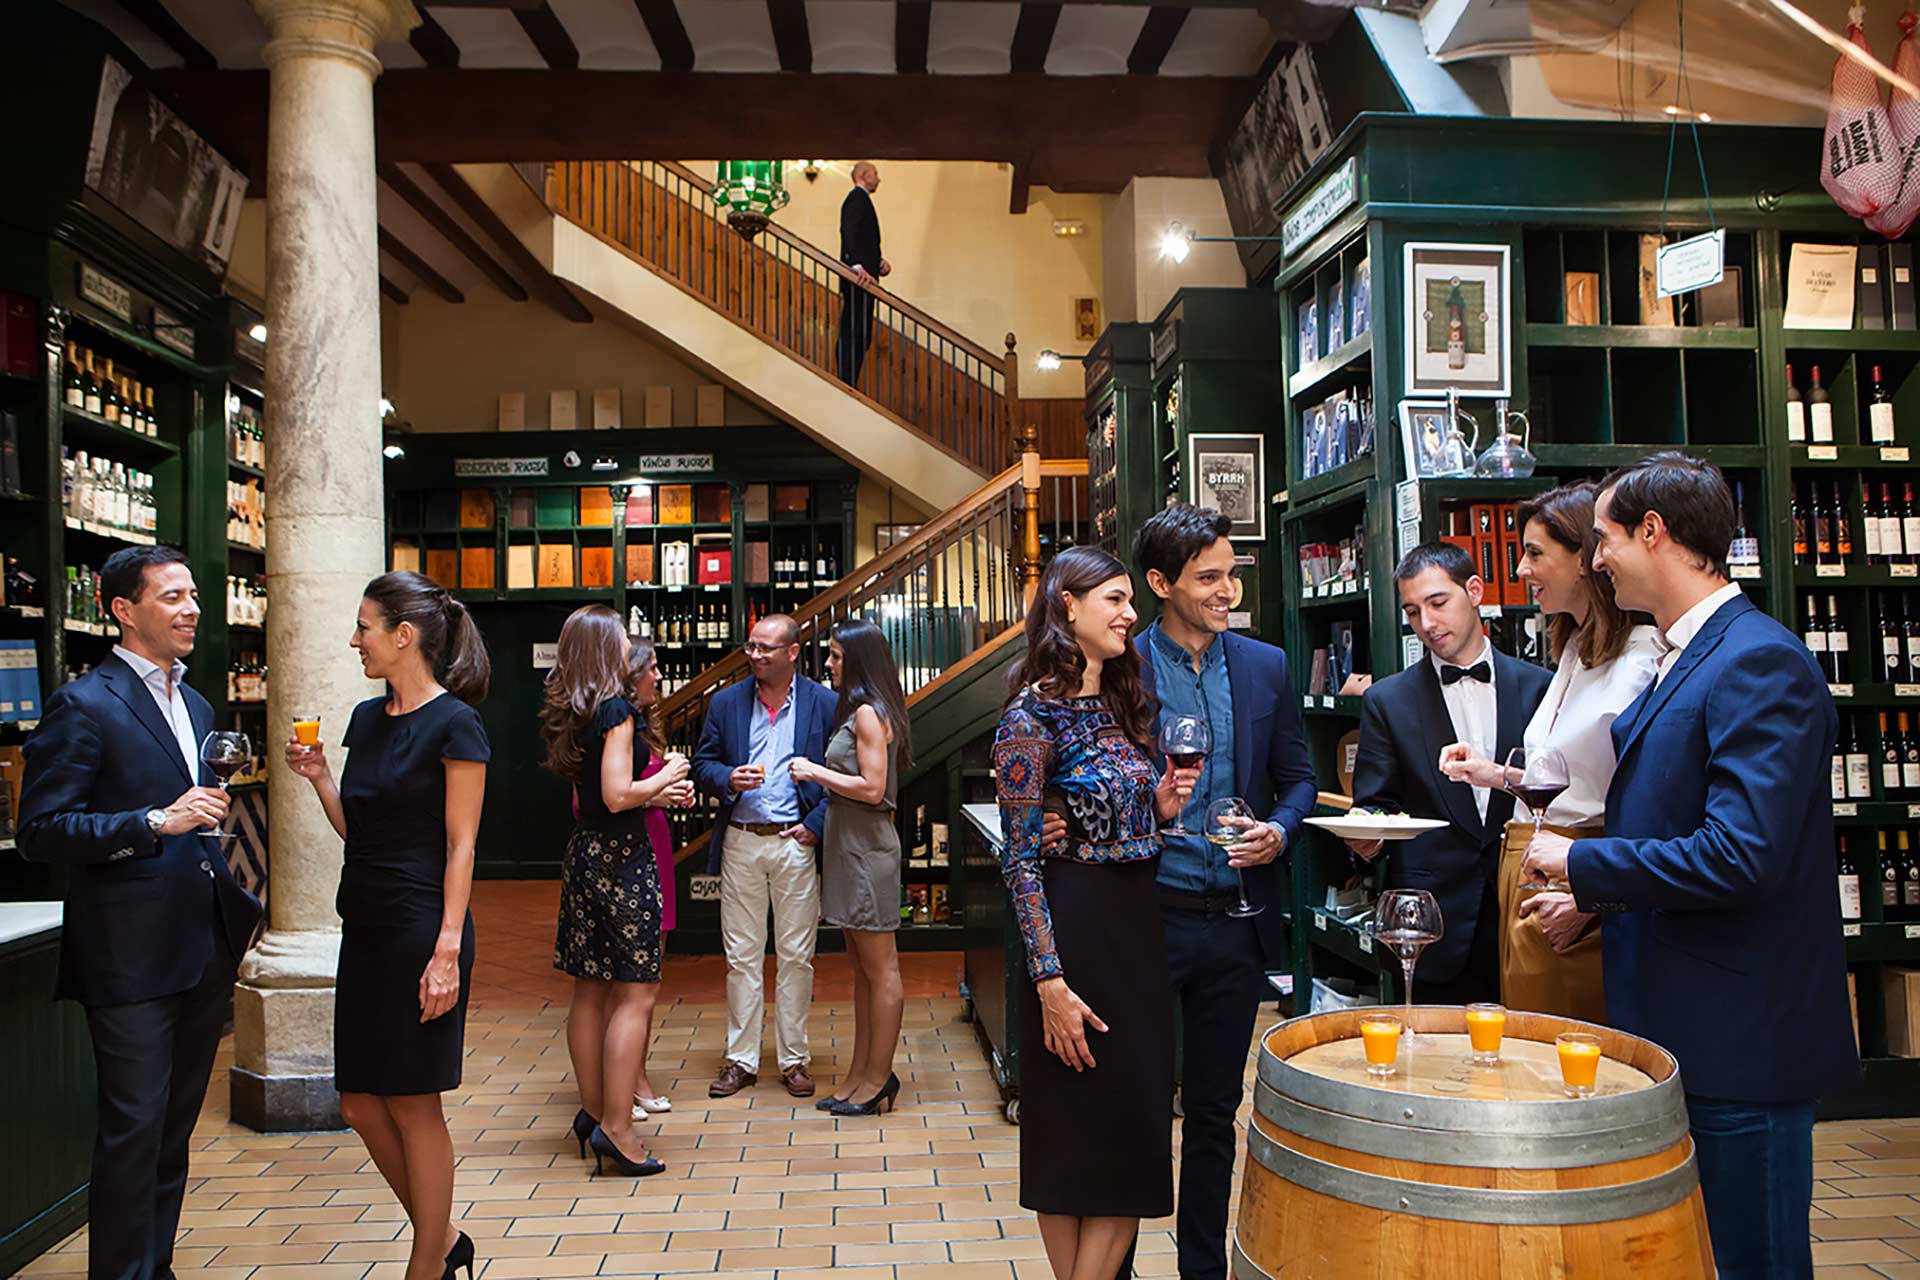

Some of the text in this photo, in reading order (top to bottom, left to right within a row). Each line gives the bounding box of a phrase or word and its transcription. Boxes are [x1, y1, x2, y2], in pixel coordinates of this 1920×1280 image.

[1849, 120, 1870, 166] ARAGON
[677, 457, 710, 469] RIOJA
[1209, 472, 1245, 484] BYRRH
[536, 650, 556, 660] Alma
